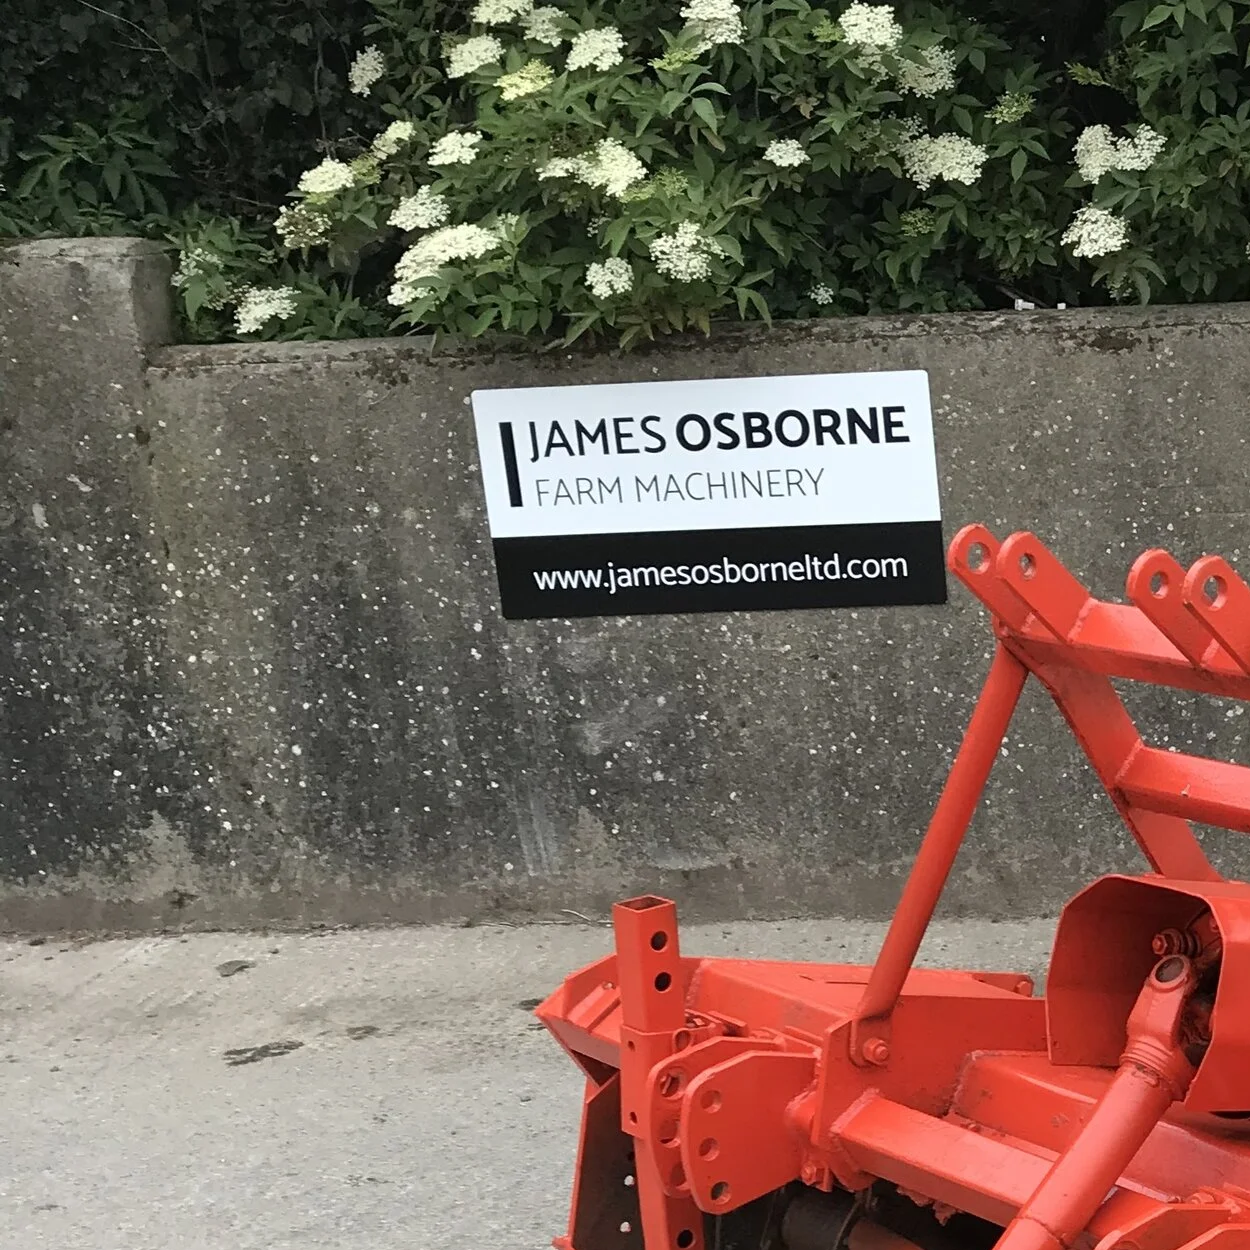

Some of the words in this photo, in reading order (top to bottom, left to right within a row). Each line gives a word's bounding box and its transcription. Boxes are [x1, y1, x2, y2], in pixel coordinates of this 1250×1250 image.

[529, 415, 666, 463] JAMES
[676, 405, 911, 451] OSBORNE
[535, 475, 624, 507] FARM
[634, 467, 825, 504] MACHINERY
[533, 553, 909, 595] www.jamesosborneltd.com
